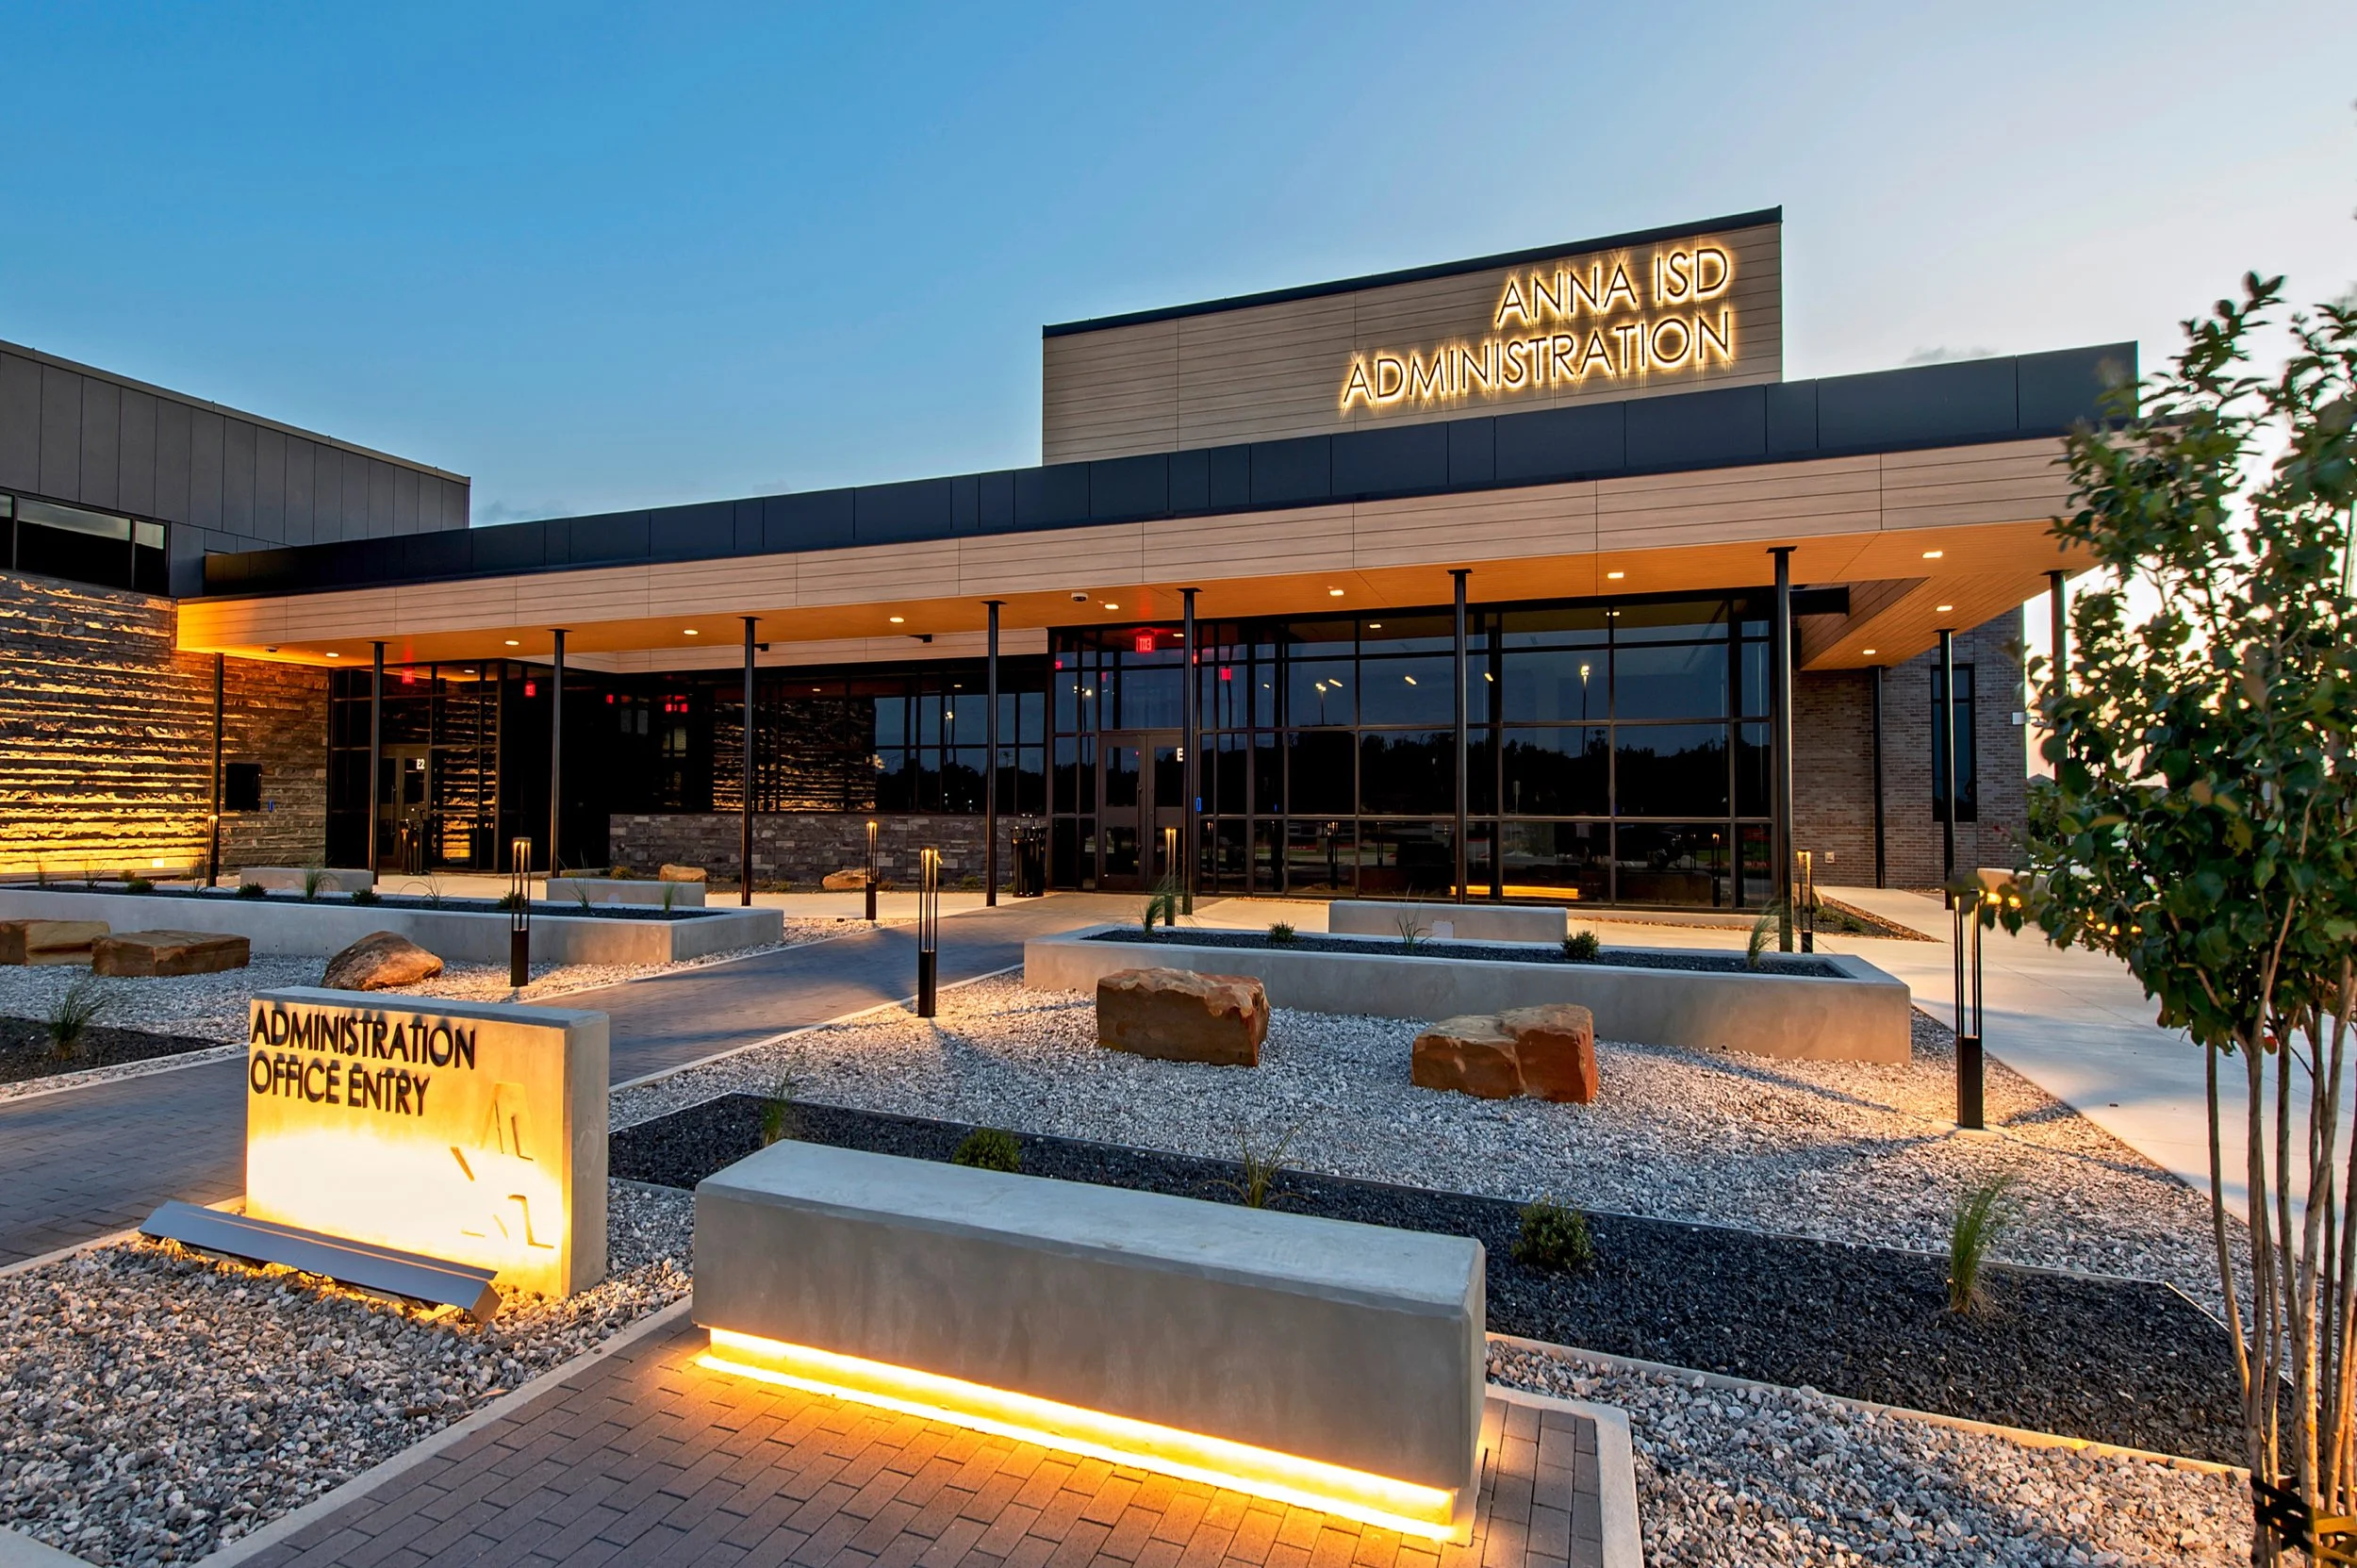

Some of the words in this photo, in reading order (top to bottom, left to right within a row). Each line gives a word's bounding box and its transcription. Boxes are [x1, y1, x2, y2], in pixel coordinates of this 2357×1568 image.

[1496, 262, 1638, 324] ANNA
[1656, 247, 1728, 302] ISD
[1343, 311, 1729, 403] ADMINISTRATION
[251, 1008, 476, 1070] ADMINISTRATION
[250, 1055, 340, 1104] OFFICE
[347, 1065, 431, 1117] ENTRY
